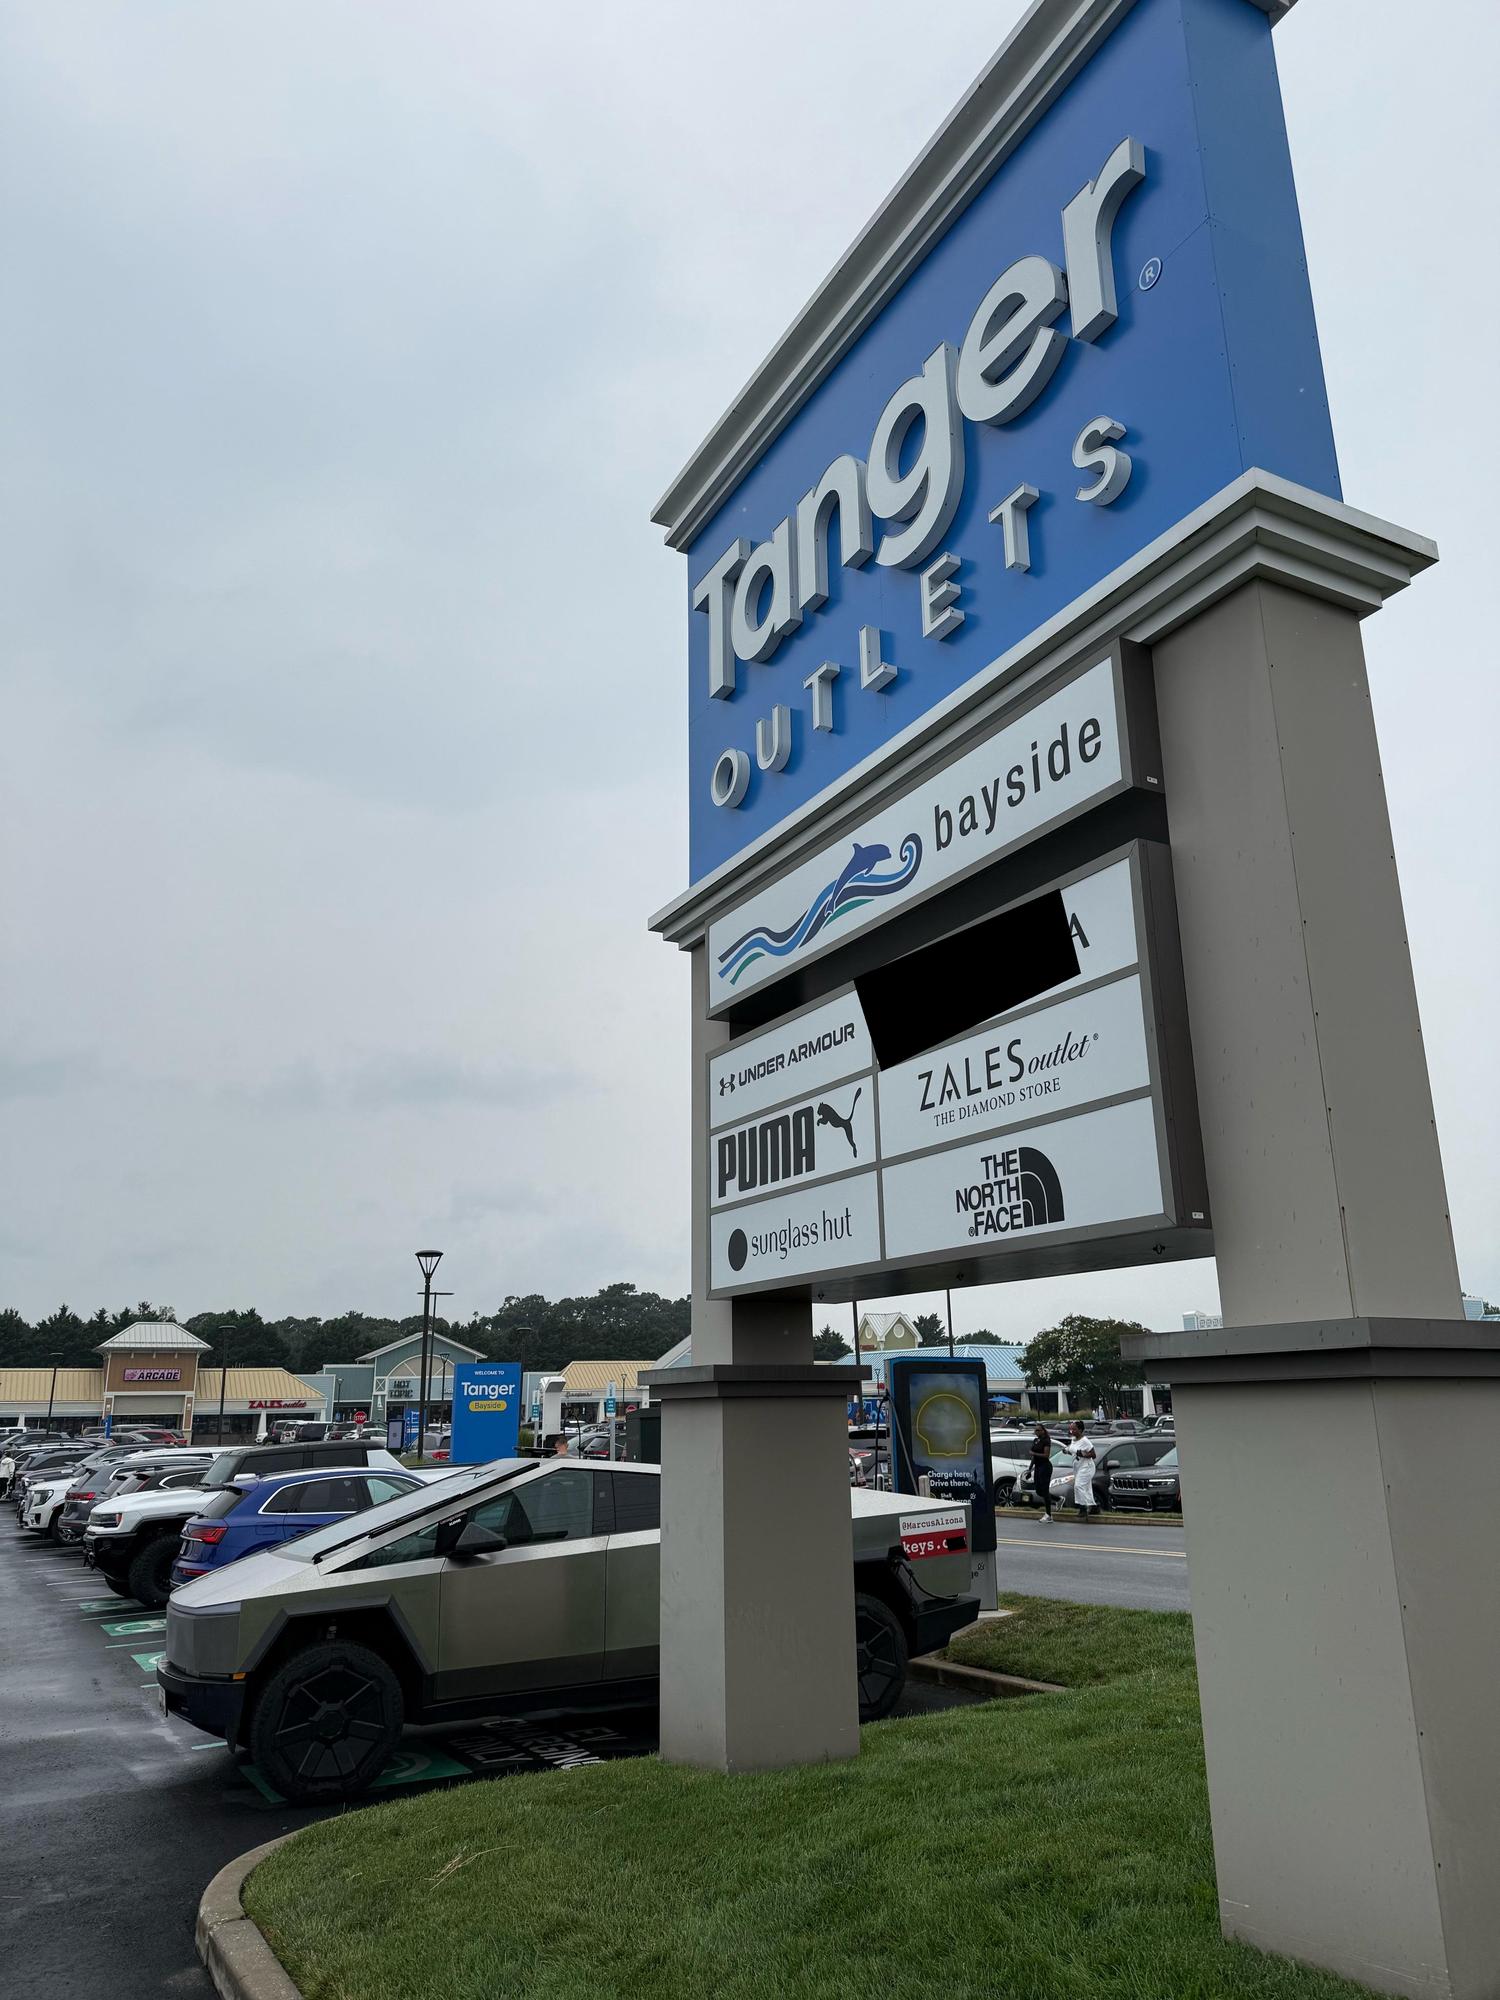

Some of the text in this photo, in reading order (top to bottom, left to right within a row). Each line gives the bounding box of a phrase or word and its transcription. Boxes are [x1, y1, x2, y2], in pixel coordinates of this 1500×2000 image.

[694, 136, 1145, 699] Tanger
[710, 416, 1132, 808] OUTLETS
[934, 716, 1102, 851] bayside
[738, 1022, 855, 1086] UNDER ARMOUR
[917, 1031, 1090, 1112] ZALES outlet
[934, 1077, 1061, 1127] THE DIAMOND STORE
[718, 1105, 815, 1198] PUMA
[980, 1149, 1019, 1180] THE
[955, 1176, 1021, 1213] NORTH
[751, 1207, 852, 1260] sunglass hut
[973, 1204, 1023, 1237] FACE
[137, 1372, 179, 1380] ARCADE
[393, 1380, 411, 1389] HOT
[461, 1381, 516, 1400] Tanger
[248, 1400, 307, 1409] ZALES outlet
[389, 1389, 413, 1398] TOPIC
[474, 1402, 502, 1410] Bayside
[927, 1470, 973, 1480] Charge here.
[930, 1479, 972, 1487] Drive there.
